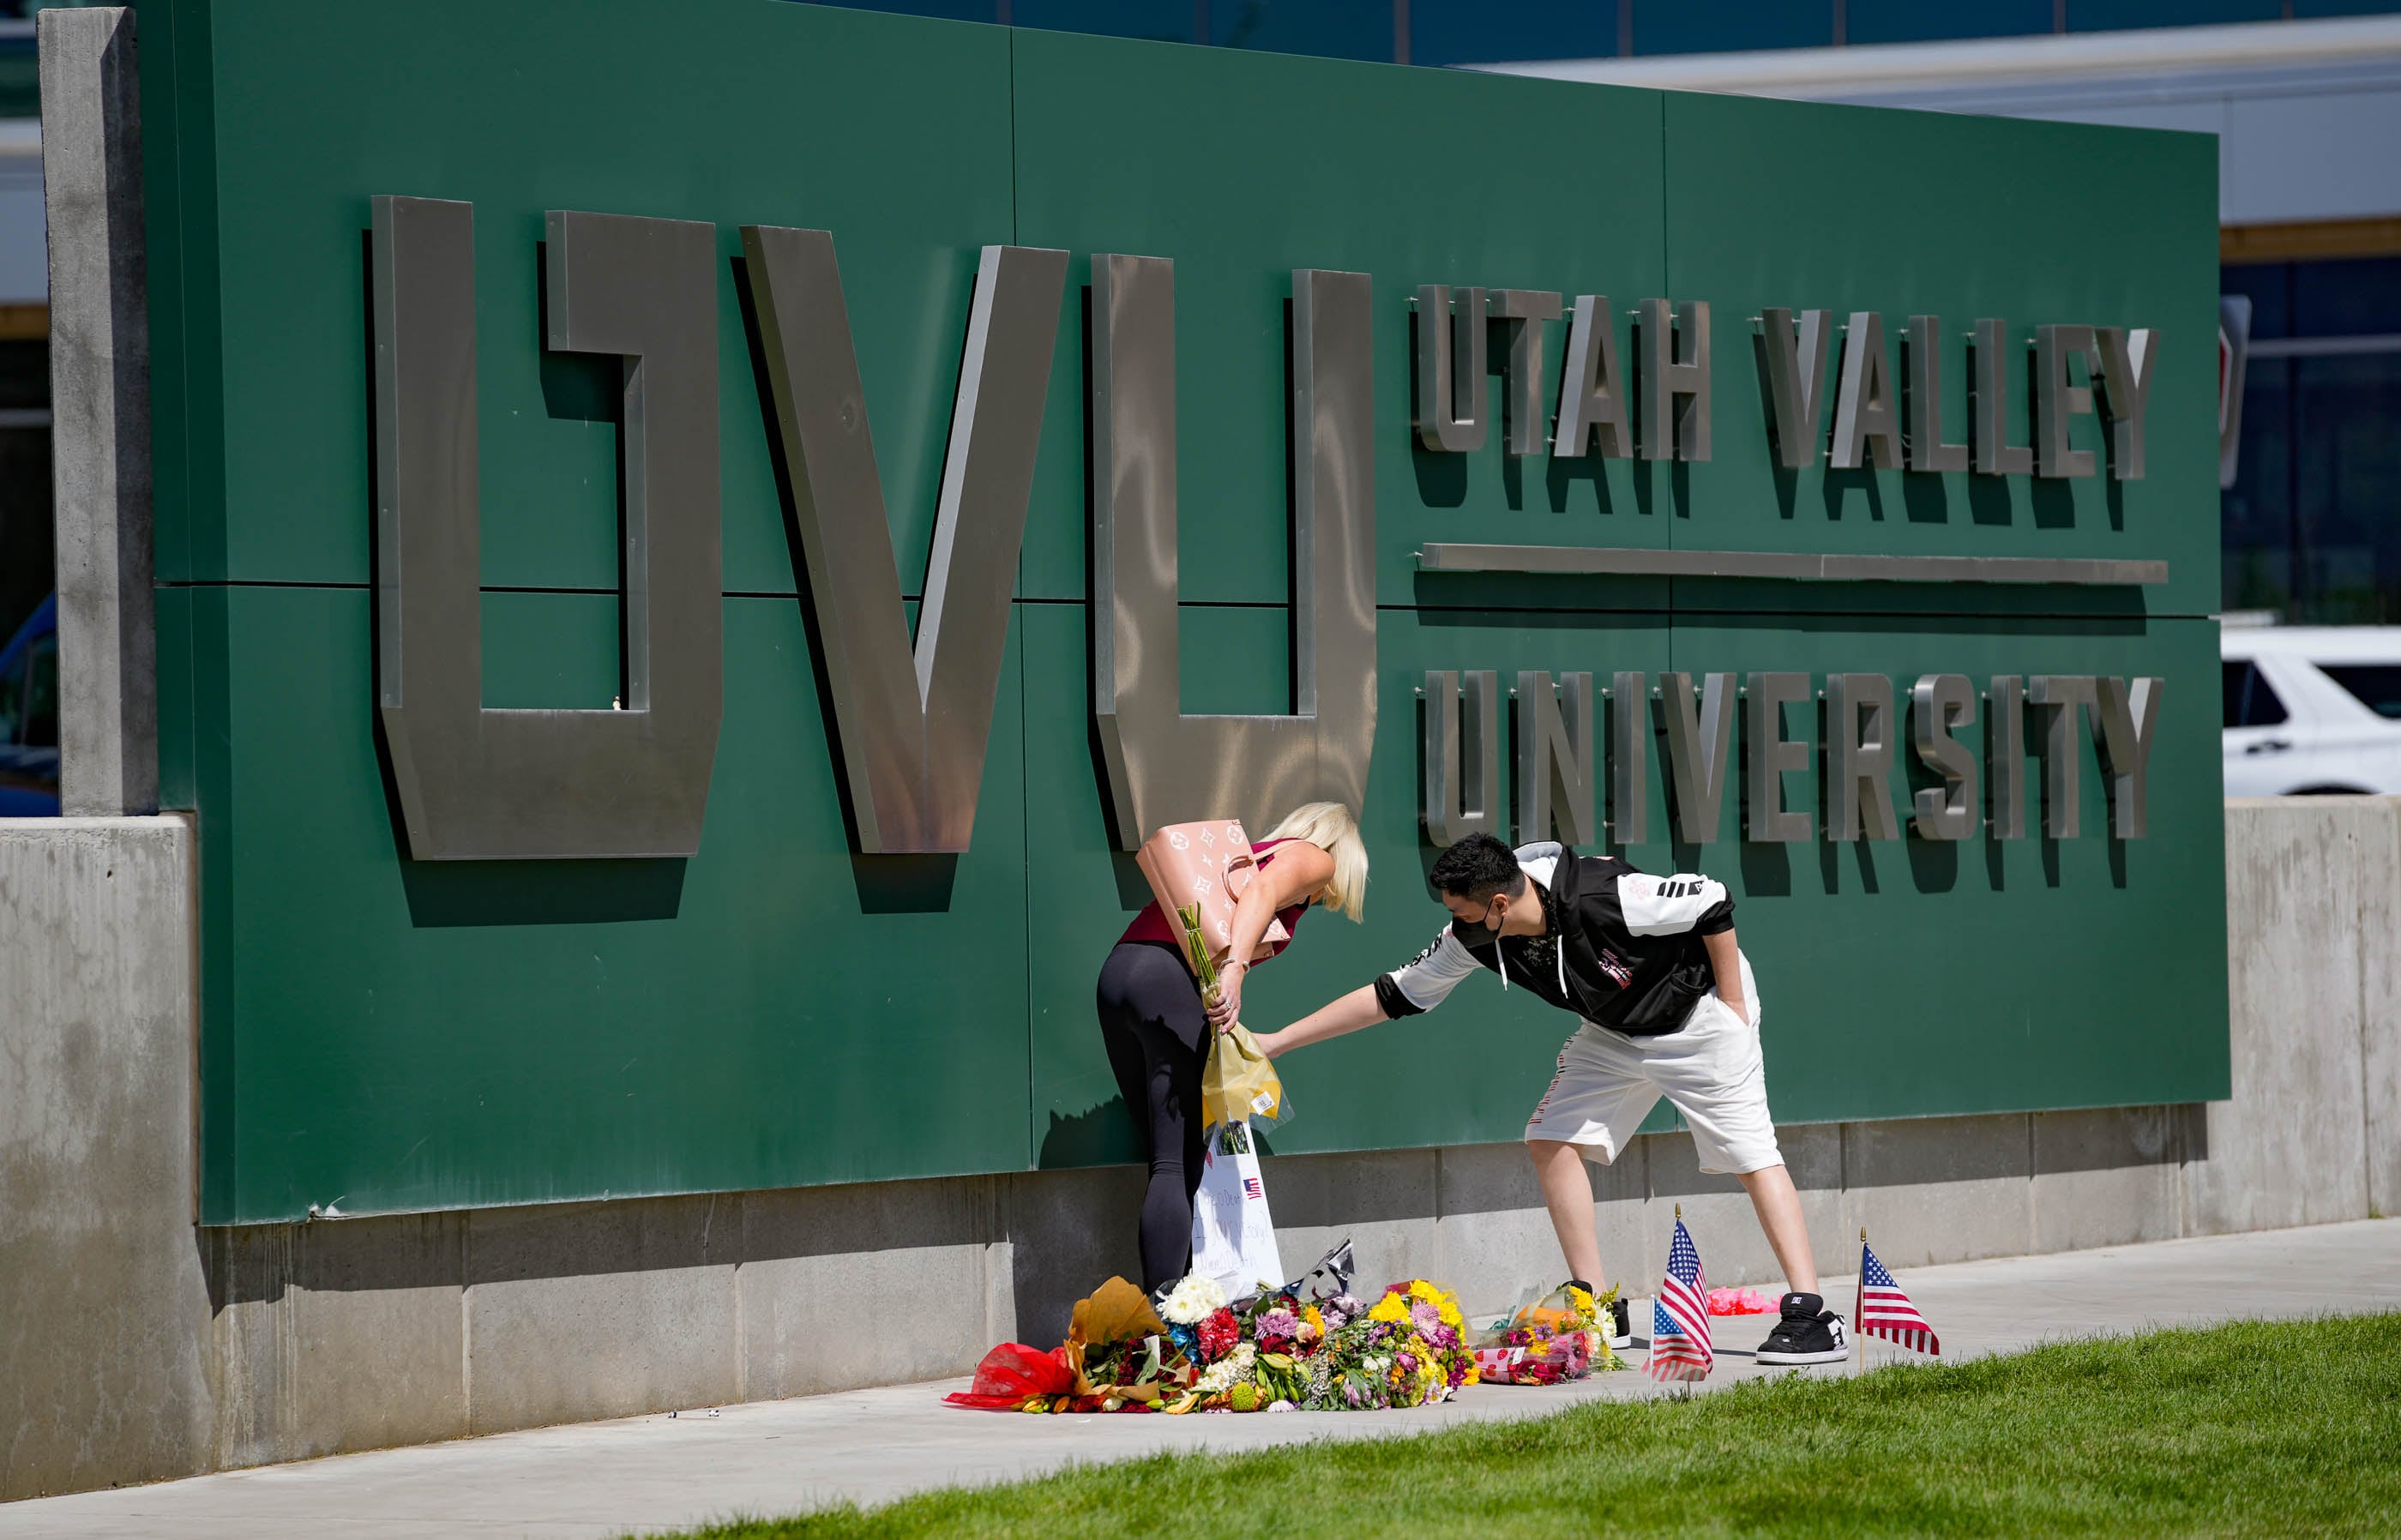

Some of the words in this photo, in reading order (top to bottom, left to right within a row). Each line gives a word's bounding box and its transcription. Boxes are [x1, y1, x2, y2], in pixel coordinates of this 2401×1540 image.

[1417, 284, 1711, 461] UTAH
[1762, 308, 2160, 479] VALLEY
[371, 195, 1376, 861] UVU
[1425, 671, 2163, 848] UNIVERSITY
